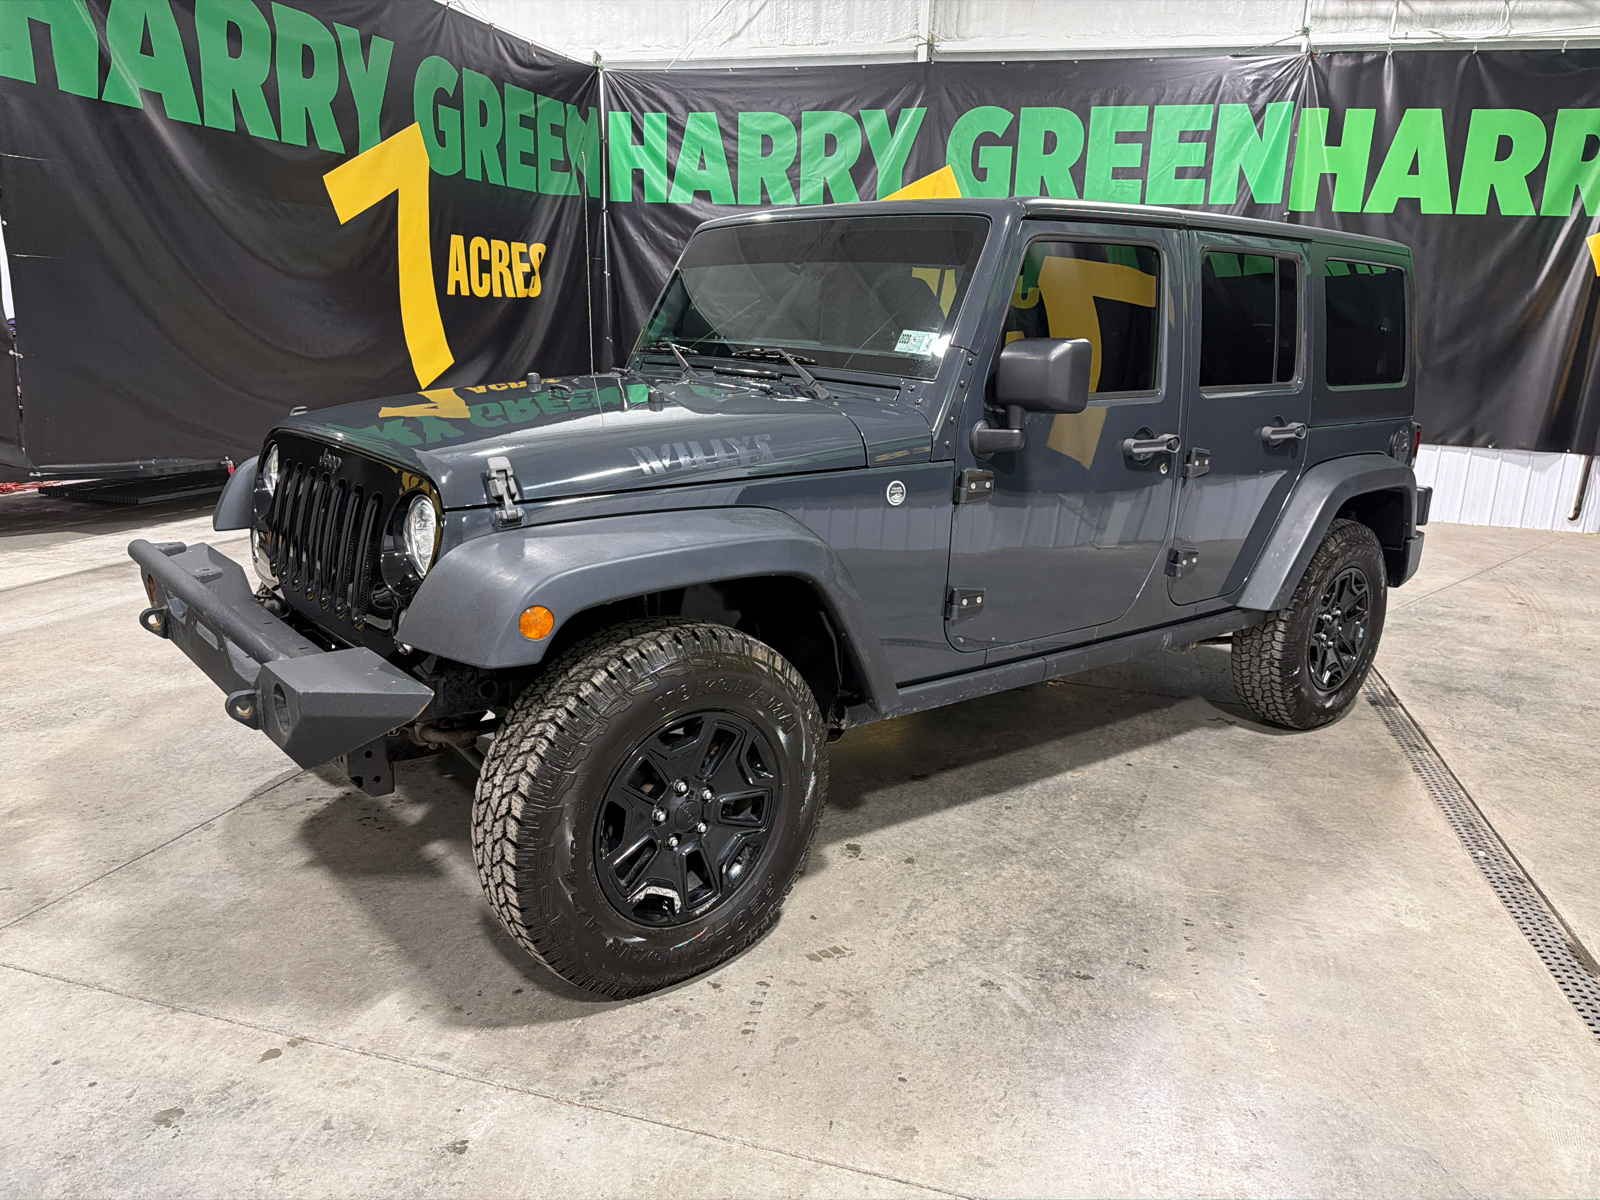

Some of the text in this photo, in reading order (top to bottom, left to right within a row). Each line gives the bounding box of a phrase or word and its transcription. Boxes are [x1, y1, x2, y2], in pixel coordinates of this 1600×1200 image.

[0, 0, 600, 198] HARRY GREEN
[608, 101, 1295, 206] HARRY GREEN
[323, 121, 455, 390] 7
[447, 233, 546, 298] ACRES
[319, 447, 342, 474] Jeep
